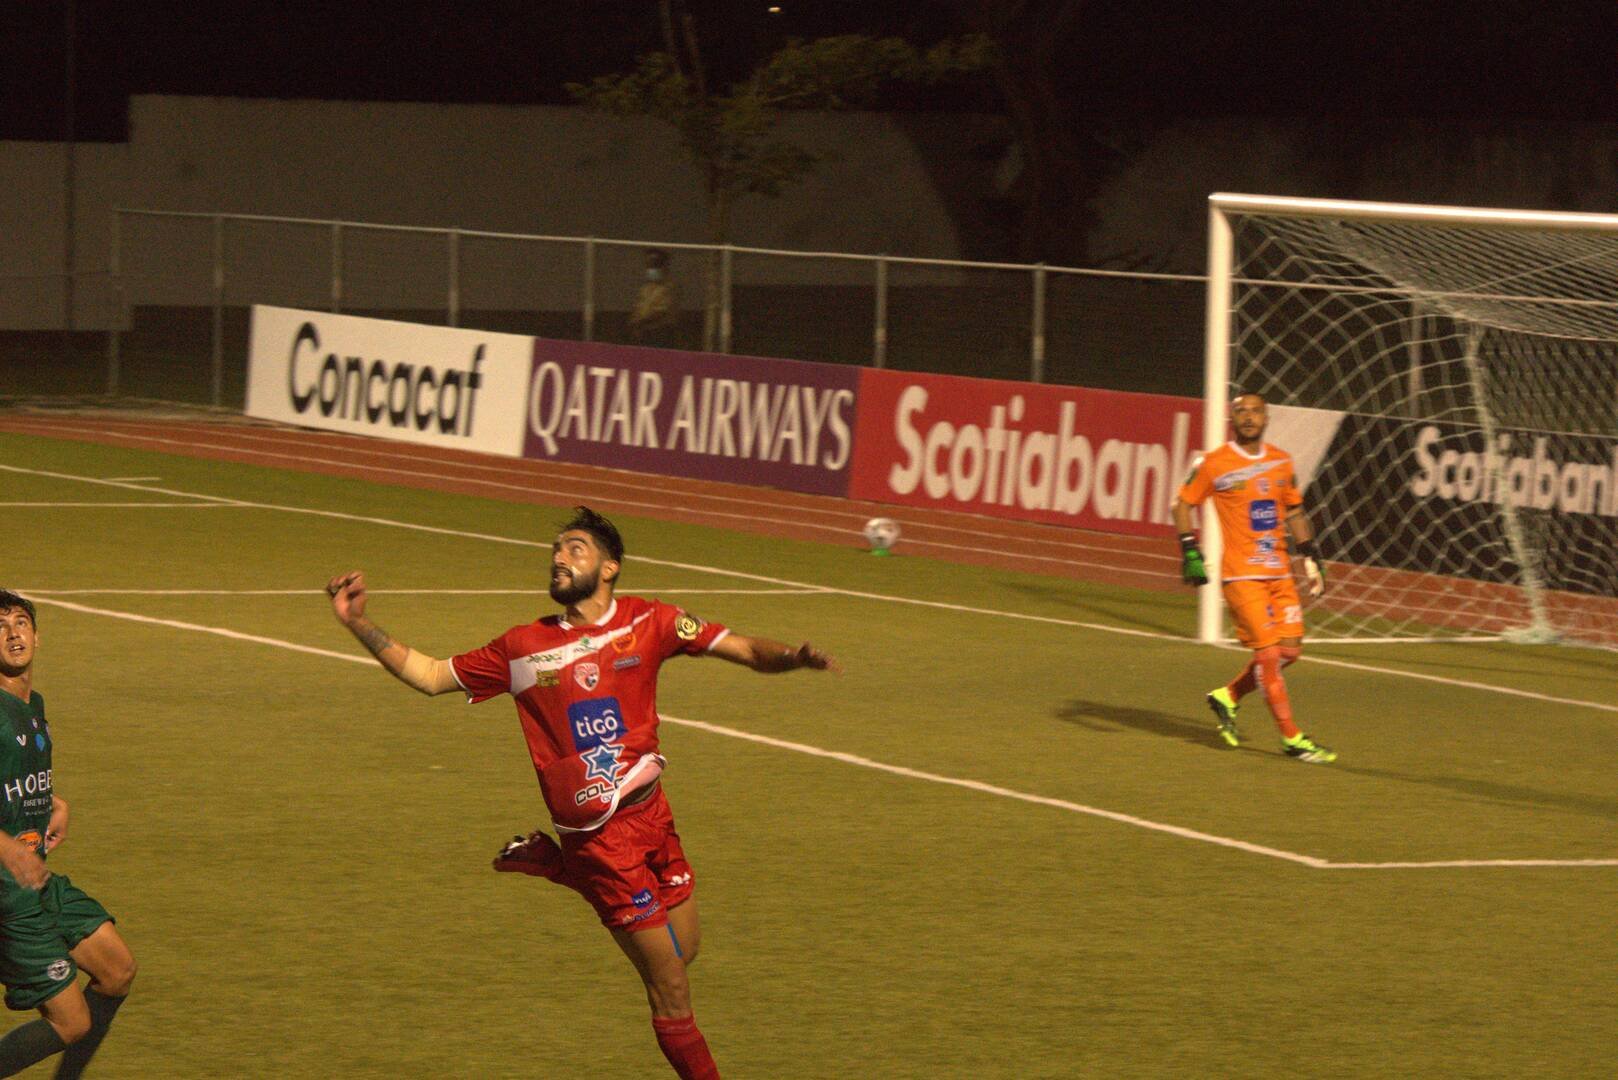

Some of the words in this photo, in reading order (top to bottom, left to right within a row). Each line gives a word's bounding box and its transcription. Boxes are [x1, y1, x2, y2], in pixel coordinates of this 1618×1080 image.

[288, 322, 487, 437] Concacaf
[529, 361, 663, 455] QATAR
[667, 374, 855, 472] AIRWAYS
[1410, 425, 1618, 517] Scotiaban
